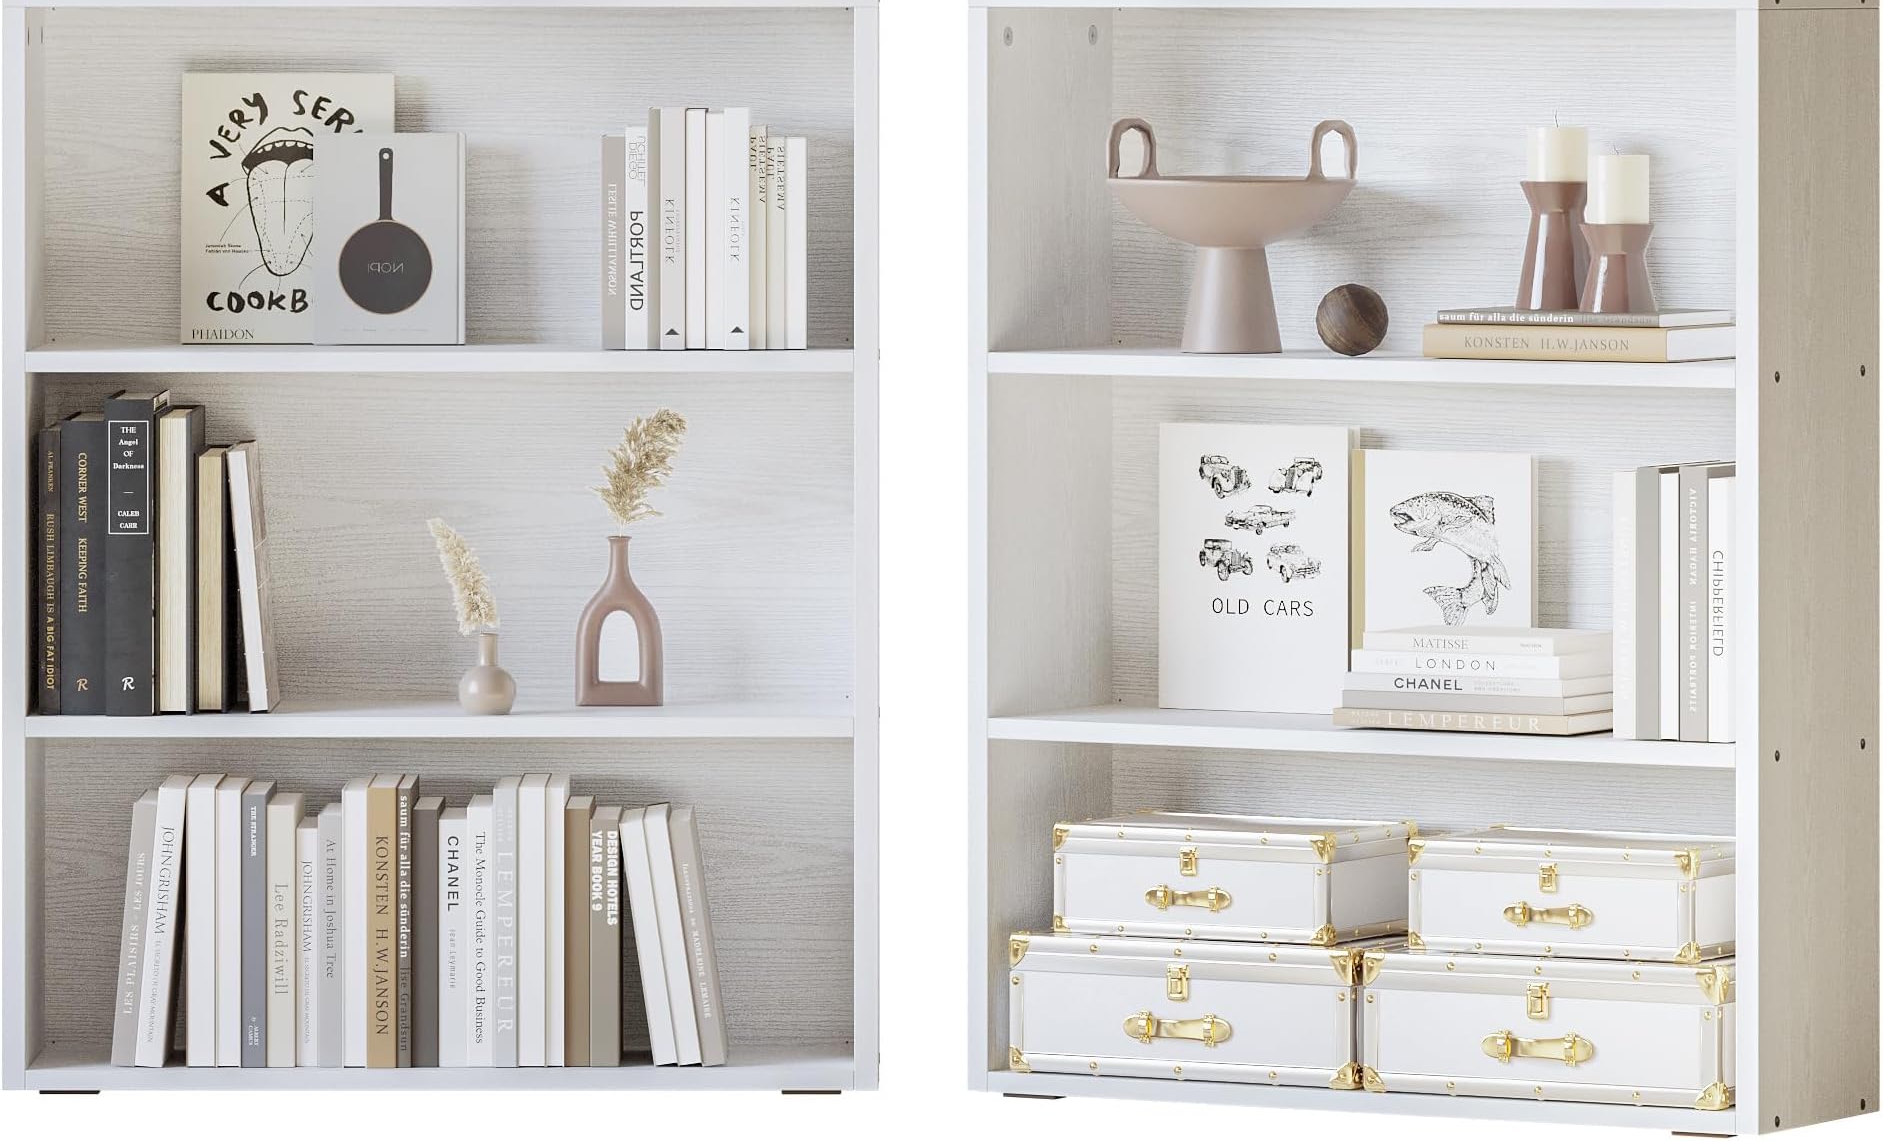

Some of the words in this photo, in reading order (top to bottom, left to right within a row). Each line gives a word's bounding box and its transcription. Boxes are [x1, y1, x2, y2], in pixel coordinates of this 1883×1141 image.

[292, 90, 364, 133] SER
[209, 92, 268, 160] VERY
[206, 182, 230, 207] A
[1469, 312, 1484, 321] für
[1509, 314, 1525, 322] die
[1528, 313, 1574, 323] sünderin
[192, 329, 254, 340] PHAIDON
[1464, 336, 1529, 348] KONSTEN
[78, 493, 87, 522] WEST
[46, 514, 55, 541] RUSH
[78, 538, 87, 578] KEEPING
[46, 545, 55, 601] LIMBAUGH
[46, 603, 55, 614] IS
[78, 580, 87, 612] FAITH
[1212, 597, 1250, 616] OLD
[1264, 599, 1314, 617] CARS
[46, 626, 55, 641] BIG
[1413, 638, 1469, 650] MATISSE
[46, 642, 55, 660] FAT
[1415, 658, 1495, 671] LONDON
[46, 662, 55, 690] IDIOT
[77, 678, 88, 692] R
[122, 676, 135, 691] R
[1394, 677, 1463, 691] CHANEL
[1388, 713, 1540, 731] LEMPEREUR
[400, 795, 408, 827] saum
[326, 839, 336, 853] At
[400, 832, 410, 850] für
[475, 831, 486, 856] The
[592, 830, 602, 863] YEAR
[607, 830, 618, 874] DESIGN
[326, 858, 336, 891] Home
[376, 836, 388, 916] KONSTEN
[400, 852, 410, 876] alla
[447, 836, 459, 912] CHANEL
[400, 879, 410, 899] die
[475, 859, 486, 906] Monocle
[592, 867, 602, 900] BOOK
[275, 884, 288, 911] Lee
[326, 894, 336, 904] in
[592, 902, 602, 911] 9
[607, 879, 618, 926] HOTELS
[323, 909, 336, 949] Joshua
[400, 902, 410, 958] sünderin
[475, 910, 486, 943] Guide
[275, 913, 288, 994] Radziwill
[475, 946, 486, 958] to
[497, 851, 513, 1033] LEMPEREUR
[125, 924, 139, 989] PLAISIRS
[326, 953, 336, 978] Tree
[373, 929, 388, 1035] H.W.JANSON
[475, 960, 486, 991] Good
[123, 991, 134, 1015] LES
[475, 995, 486, 1044] Business
